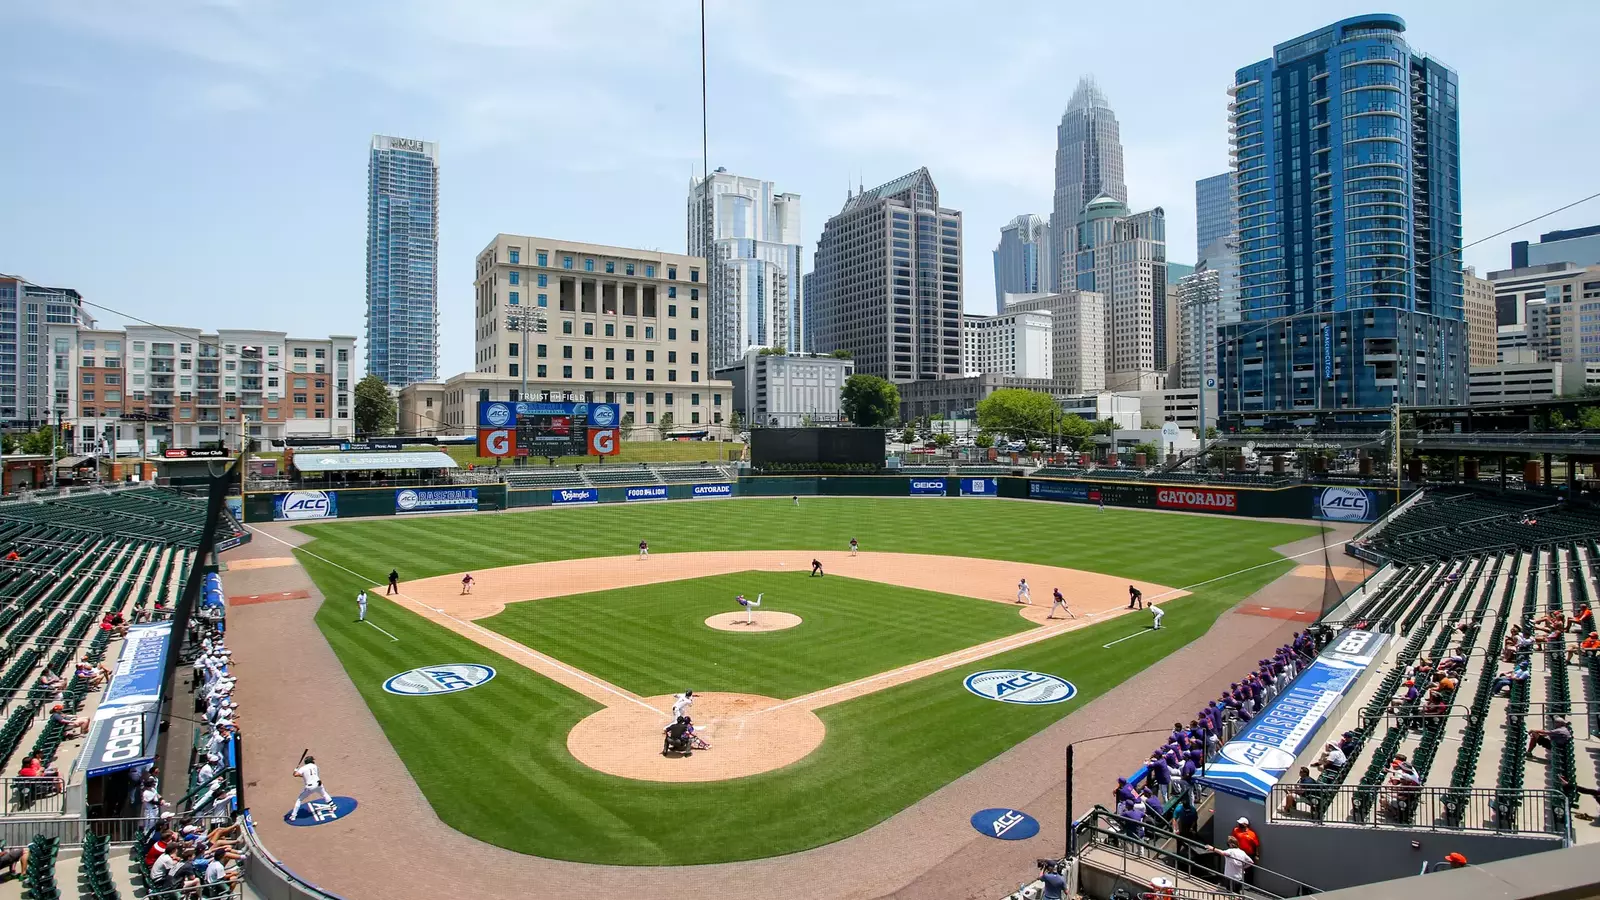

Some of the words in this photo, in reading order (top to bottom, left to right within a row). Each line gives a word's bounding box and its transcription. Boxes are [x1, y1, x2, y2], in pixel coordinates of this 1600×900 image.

[400, 139, 422, 149] VUE
[519, 392, 549, 400] TRUIST
[562, 393, 585, 401] FIELD
[486, 430, 509, 455] G
[593, 430, 613, 453] G
[418, 490, 474, 501] BASEBALL
[560, 490, 590, 500] Bojangles
[628, 489, 644, 497] FOOD
[652, 488, 665, 496] LION
[694, 485, 730, 493] GATORADE
[289, 499, 327, 509] ACC
[1158, 490, 1235, 507] GATORADE
[1327, 496, 1367, 508] ACC
[1335, 630, 1373, 654] GEICO
[424, 670, 474, 689] ACC
[996, 672, 1046, 696] ACC
[1247, 687, 1325, 748] BASEBALL
[101, 714, 143, 763] GEICO
[1243, 743, 1269, 764] ACC
[992, 810, 1022, 834] ACC
